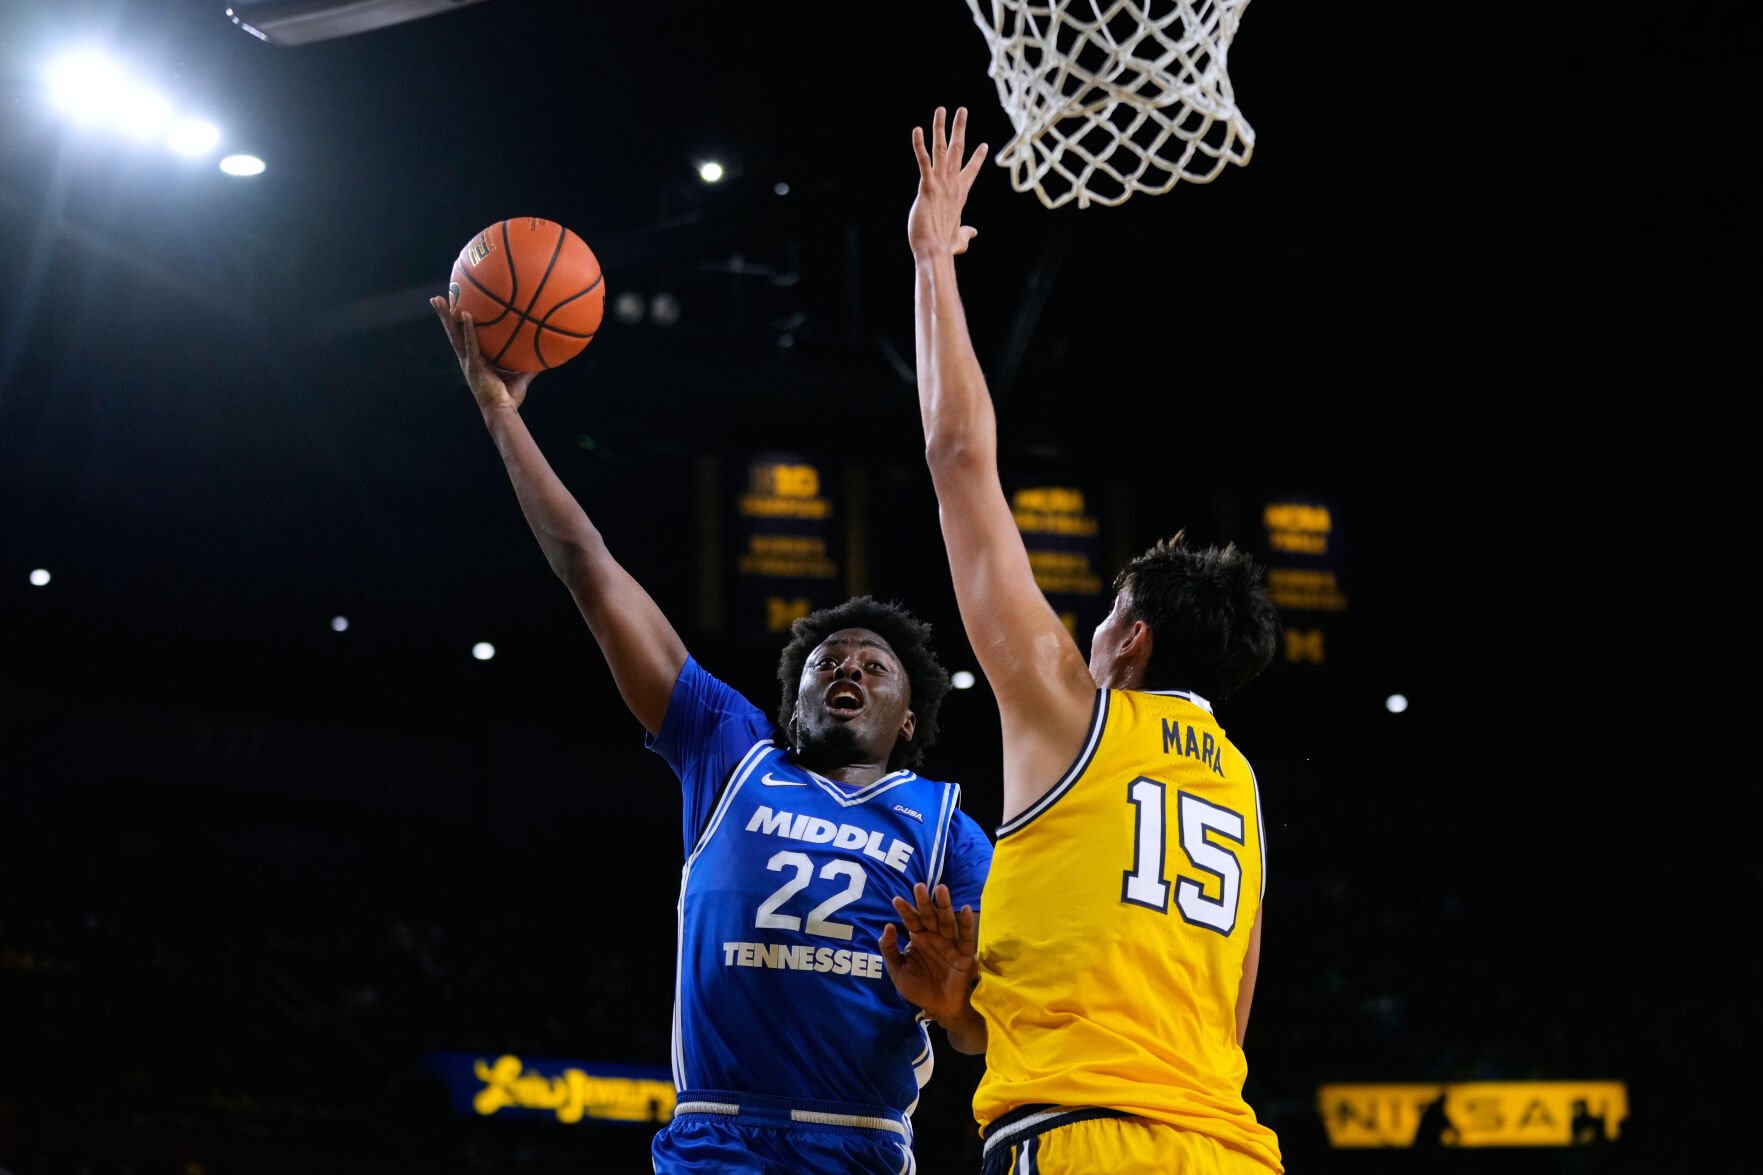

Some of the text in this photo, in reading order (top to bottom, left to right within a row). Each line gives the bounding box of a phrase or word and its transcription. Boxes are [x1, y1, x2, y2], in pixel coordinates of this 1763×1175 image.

[1162, 718, 1224, 777] MARA
[745, 805, 915, 873] MIDDLE
[1121, 775, 1244, 938] 15
[755, 850, 867, 941] 22
[723, 942, 883, 980] TENNESSEE
